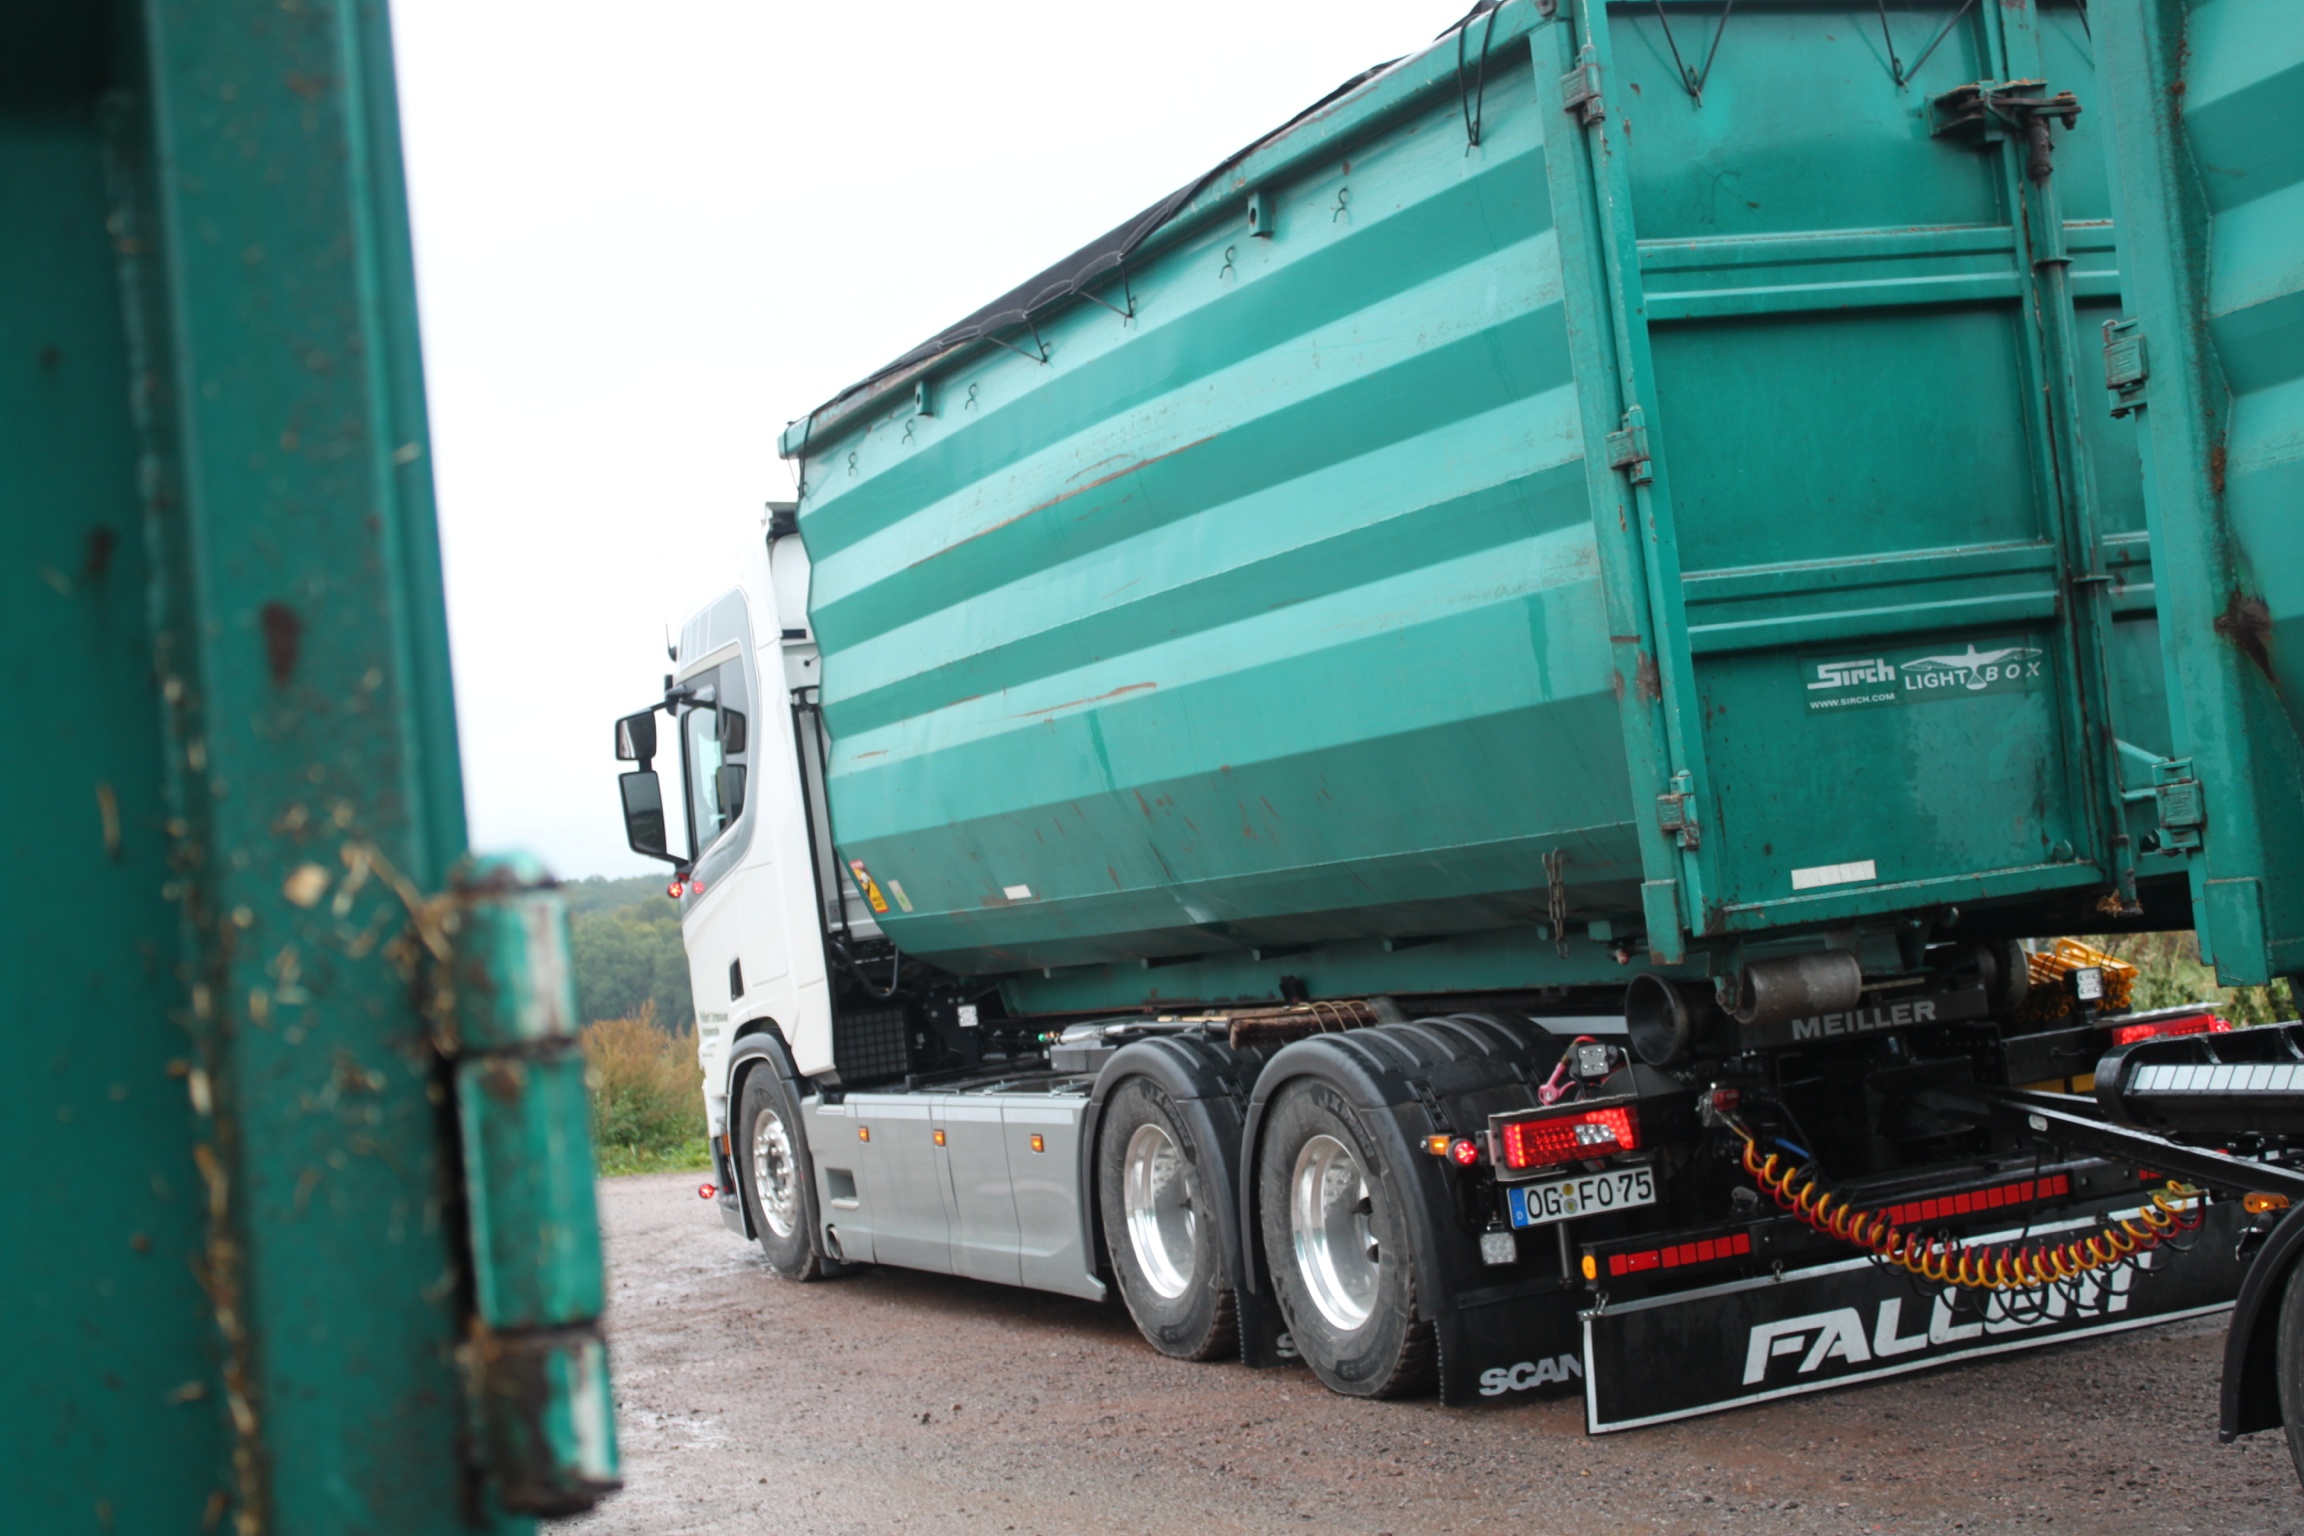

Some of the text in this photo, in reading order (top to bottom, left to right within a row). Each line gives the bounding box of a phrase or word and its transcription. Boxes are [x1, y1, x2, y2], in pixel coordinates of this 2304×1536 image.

[1904, 668, 1969, 691] LIGHT
[1809, 692, 1896, 709] WWW.SIRCH.COM
[1791, 1000, 1937, 1040] MEILLER
[1526, 1186, 1562, 1219] OG
